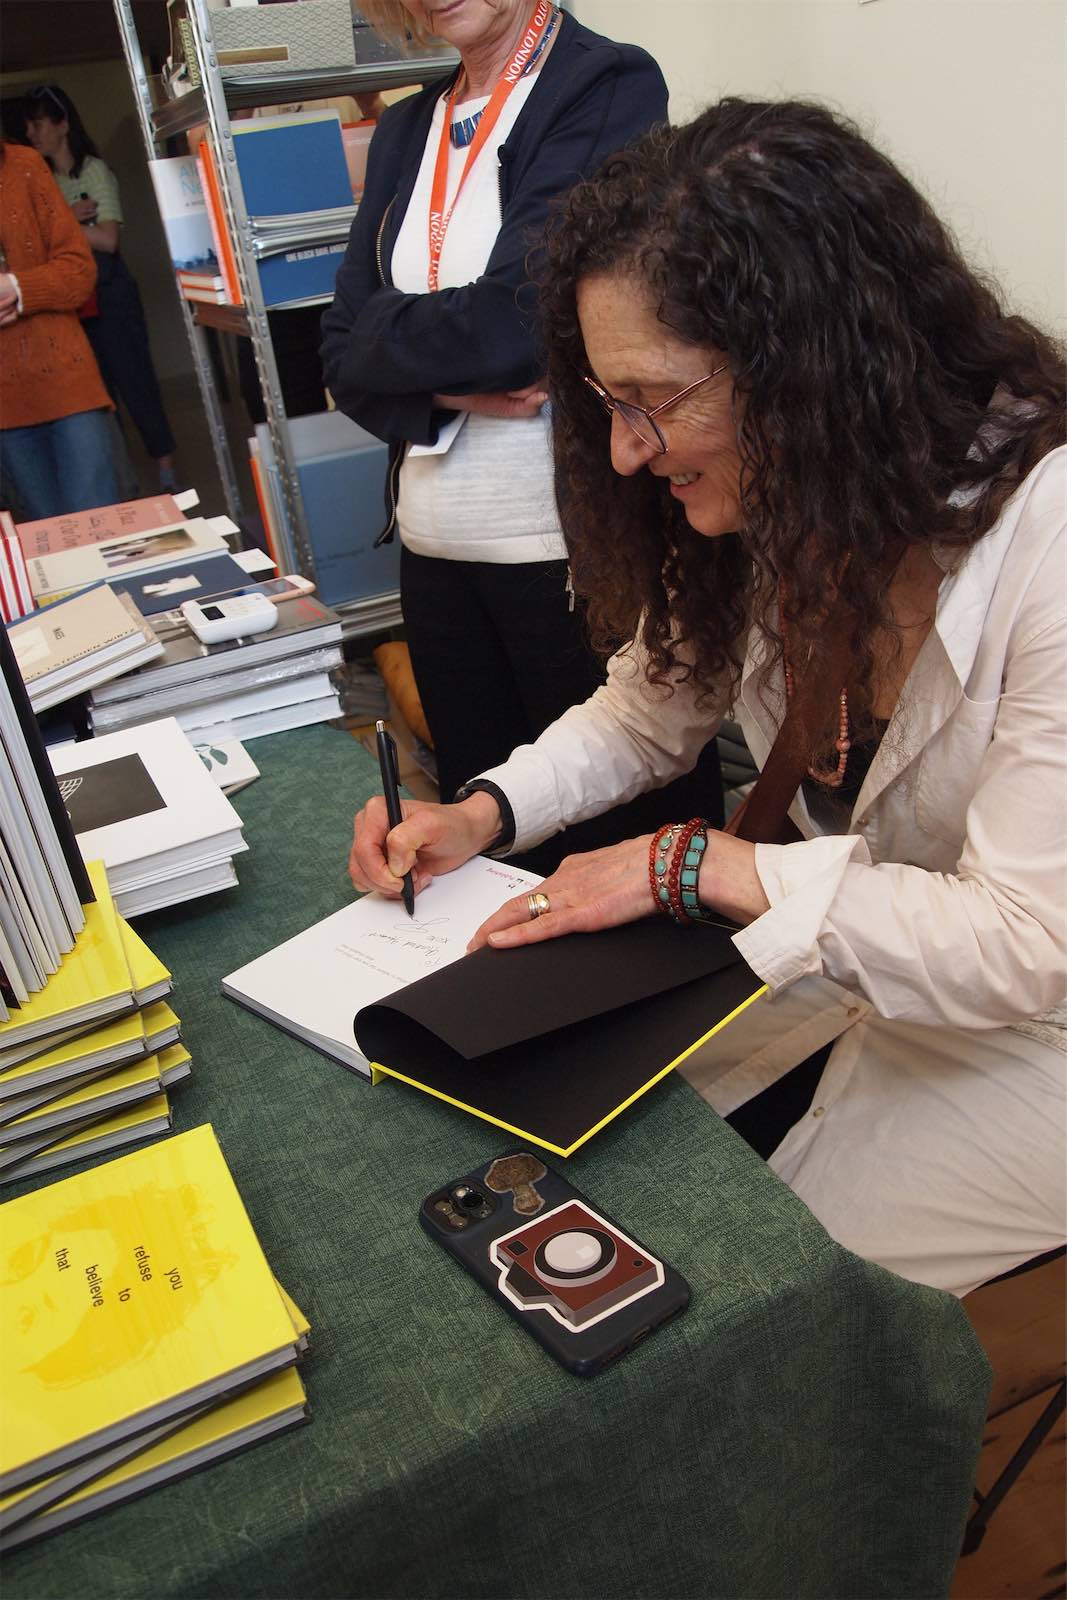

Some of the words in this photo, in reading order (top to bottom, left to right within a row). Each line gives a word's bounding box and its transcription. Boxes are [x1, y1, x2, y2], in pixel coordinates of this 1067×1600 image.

[504, 28, 538, 84] LONDON
[55, 1248, 71, 1272] that
[133, 1245, 153, 1282] refuse
[85, 1264, 104, 1308] believe
[163, 1267, 183, 1291] you
[118, 1288, 131, 1302] to
